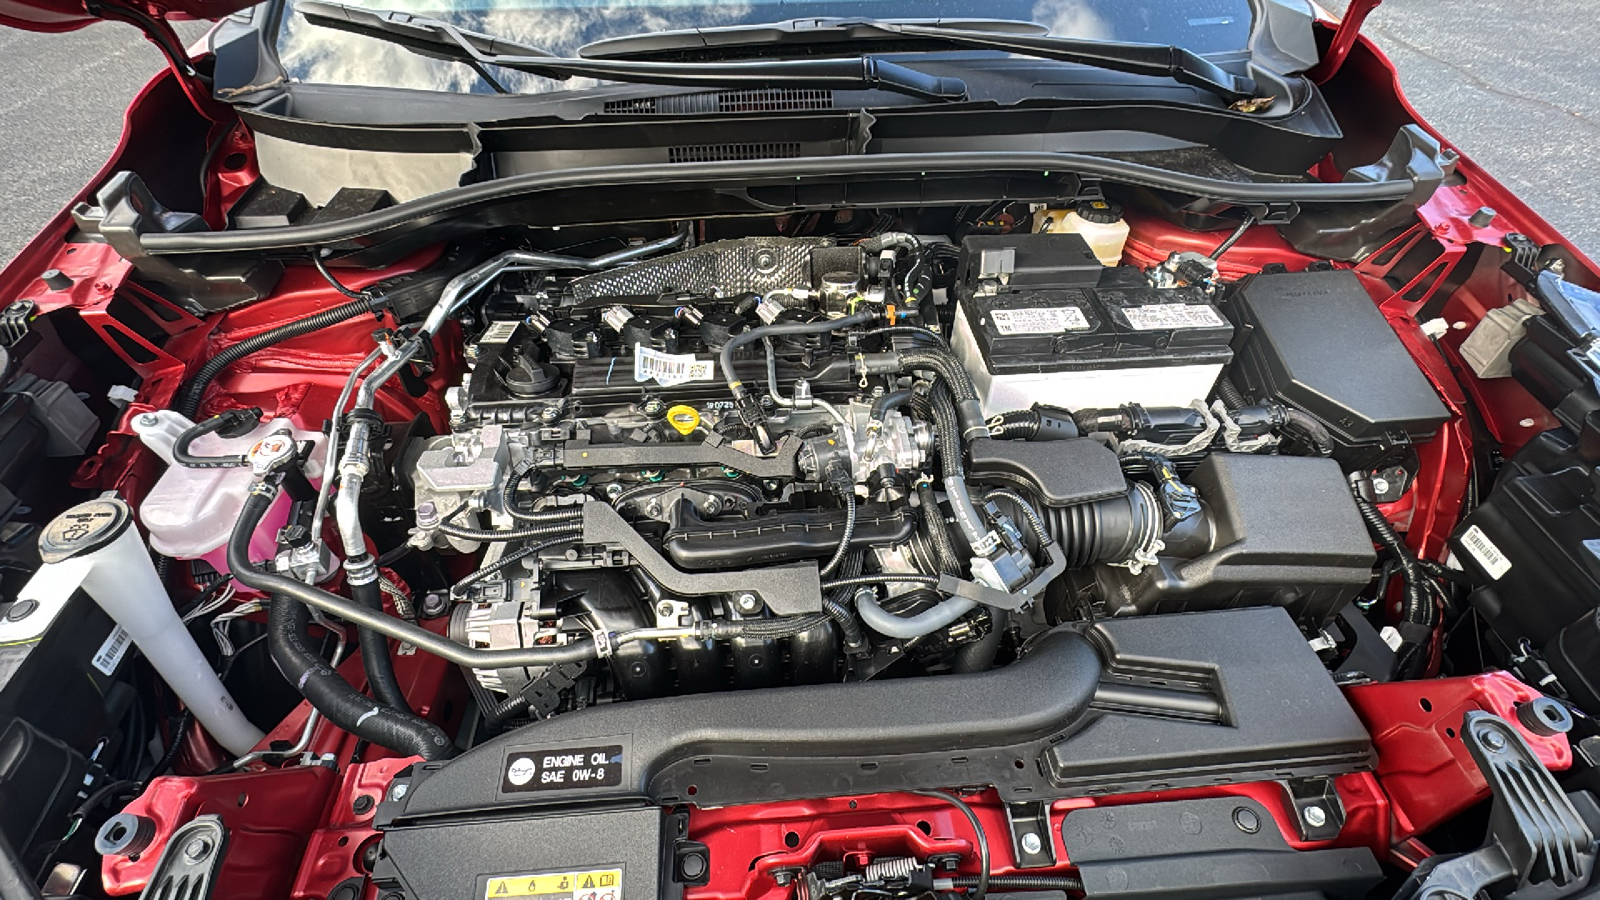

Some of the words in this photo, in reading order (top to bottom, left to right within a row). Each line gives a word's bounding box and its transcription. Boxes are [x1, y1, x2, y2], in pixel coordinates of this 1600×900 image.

[543, 754, 585, 769] ENGINE
[591, 753, 609, 766] OIL
[541, 770, 565, 784] SAE
[572, 767, 605, 782] 0W-8
